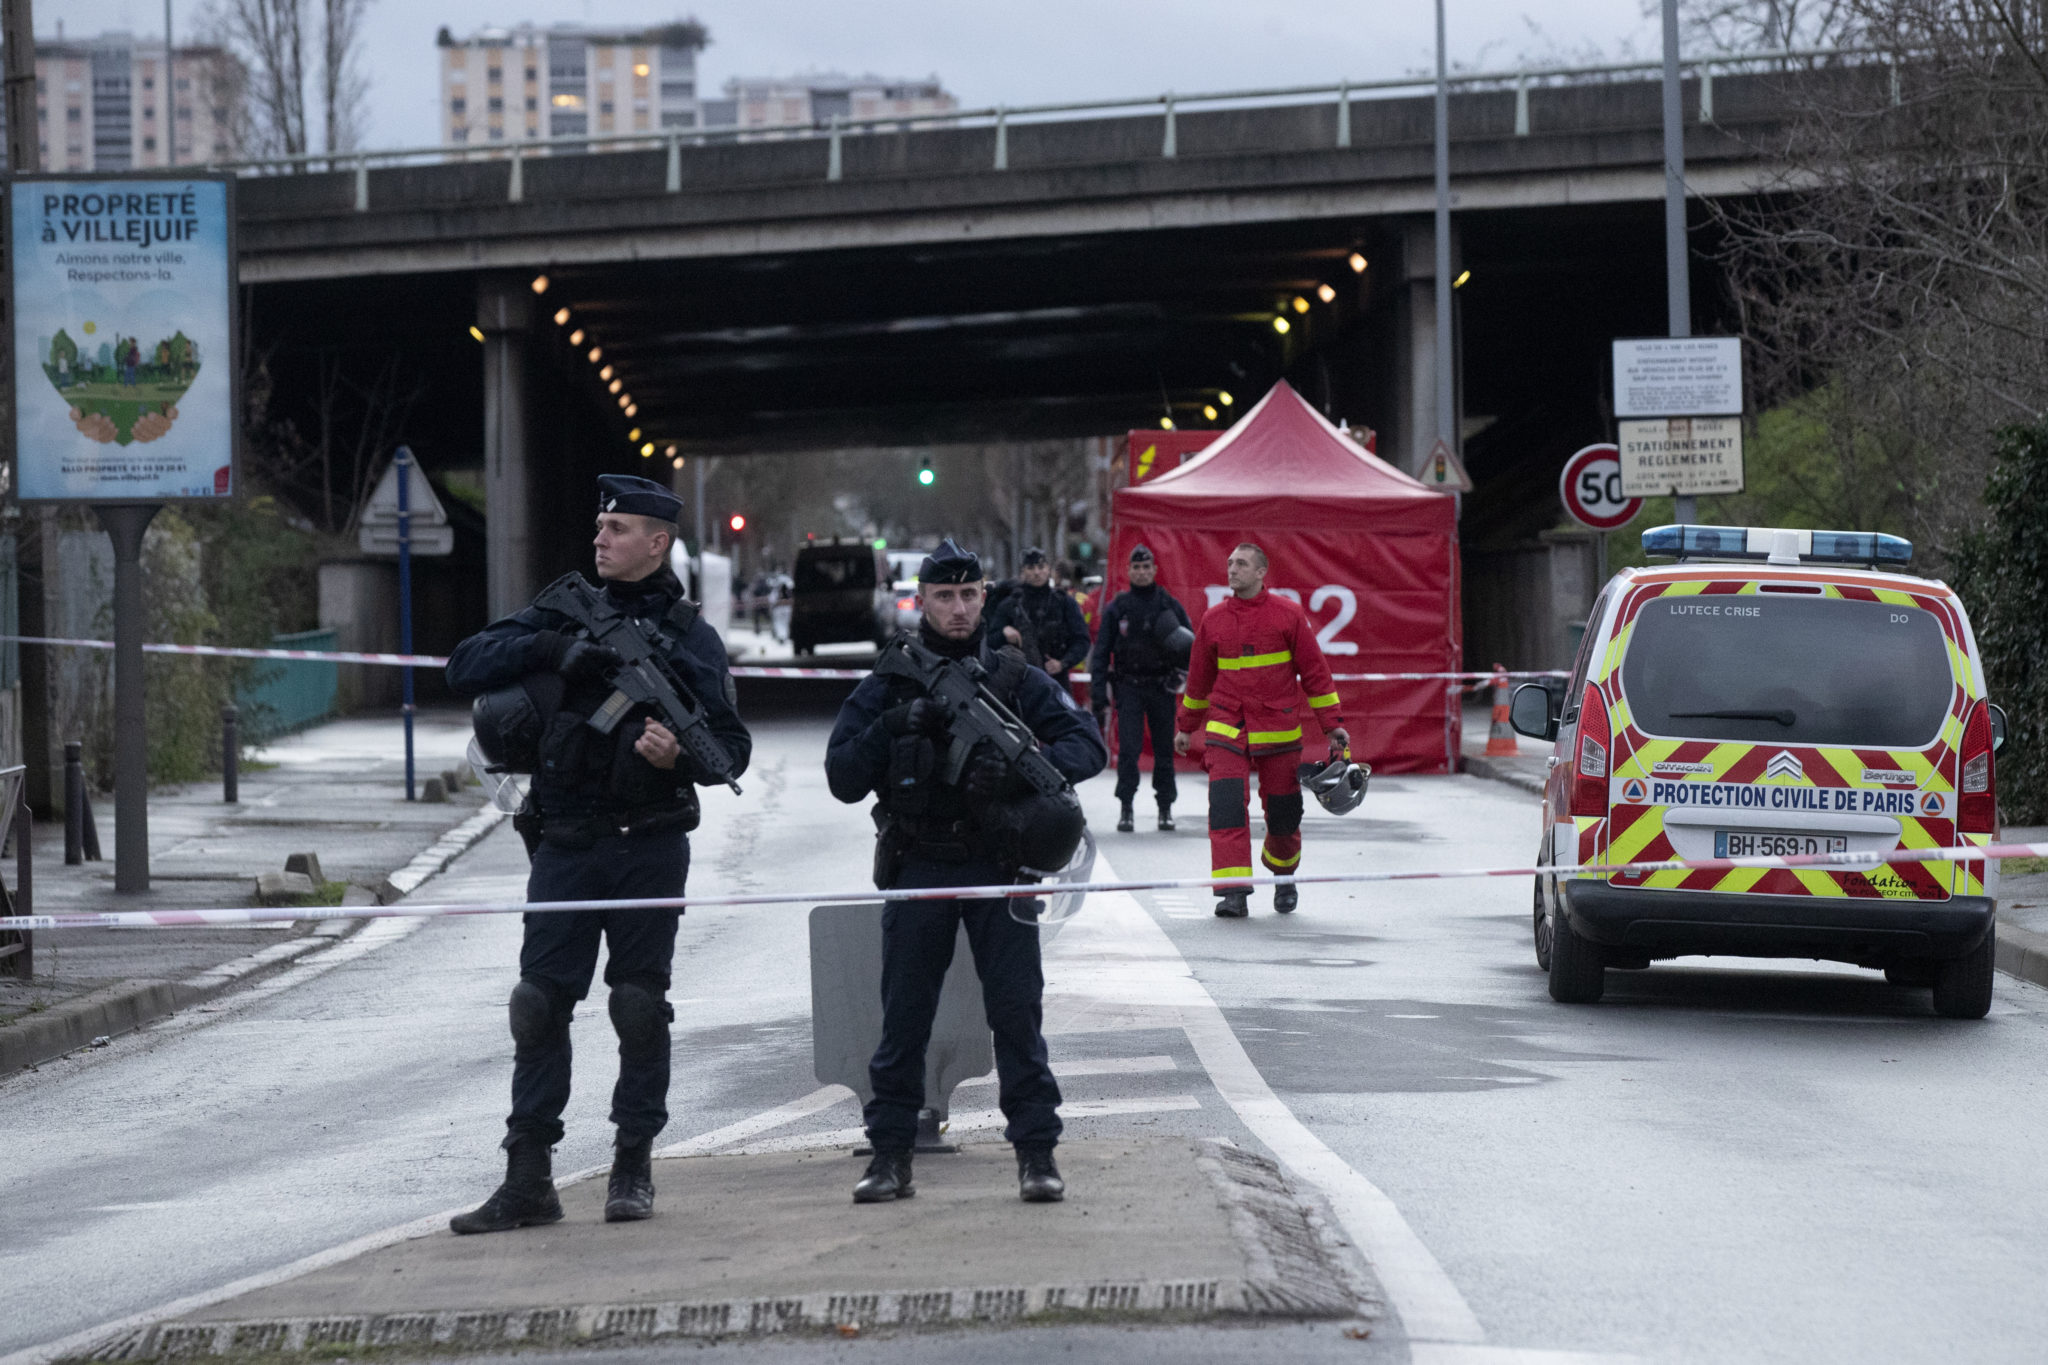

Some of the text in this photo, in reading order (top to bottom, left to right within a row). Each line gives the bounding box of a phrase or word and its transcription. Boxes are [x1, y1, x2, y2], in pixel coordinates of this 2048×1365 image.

[43, 184, 196, 217] PROPRETÉ
[42, 219, 199, 248] à VILLEJUIF
[56, 253, 109, 264] Aimons
[113, 254, 151, 264] notre
[1627, 438, 1733, 453] STATIONNEMENT
[1638, 453, 1723, 466] REGLEMENTE
[1582, 472, 1625, 505] 50
[1670, 605, 1760, 617] LUTECE CRISE
[1890, 613, 1909, 624] DO
[1864, 770, 1915, 783] Berlingo
[1653, 783, 1915, 814] PROTECTION CIVILE DE PARIS
[1842, 872, 1917, 888] Fondation
